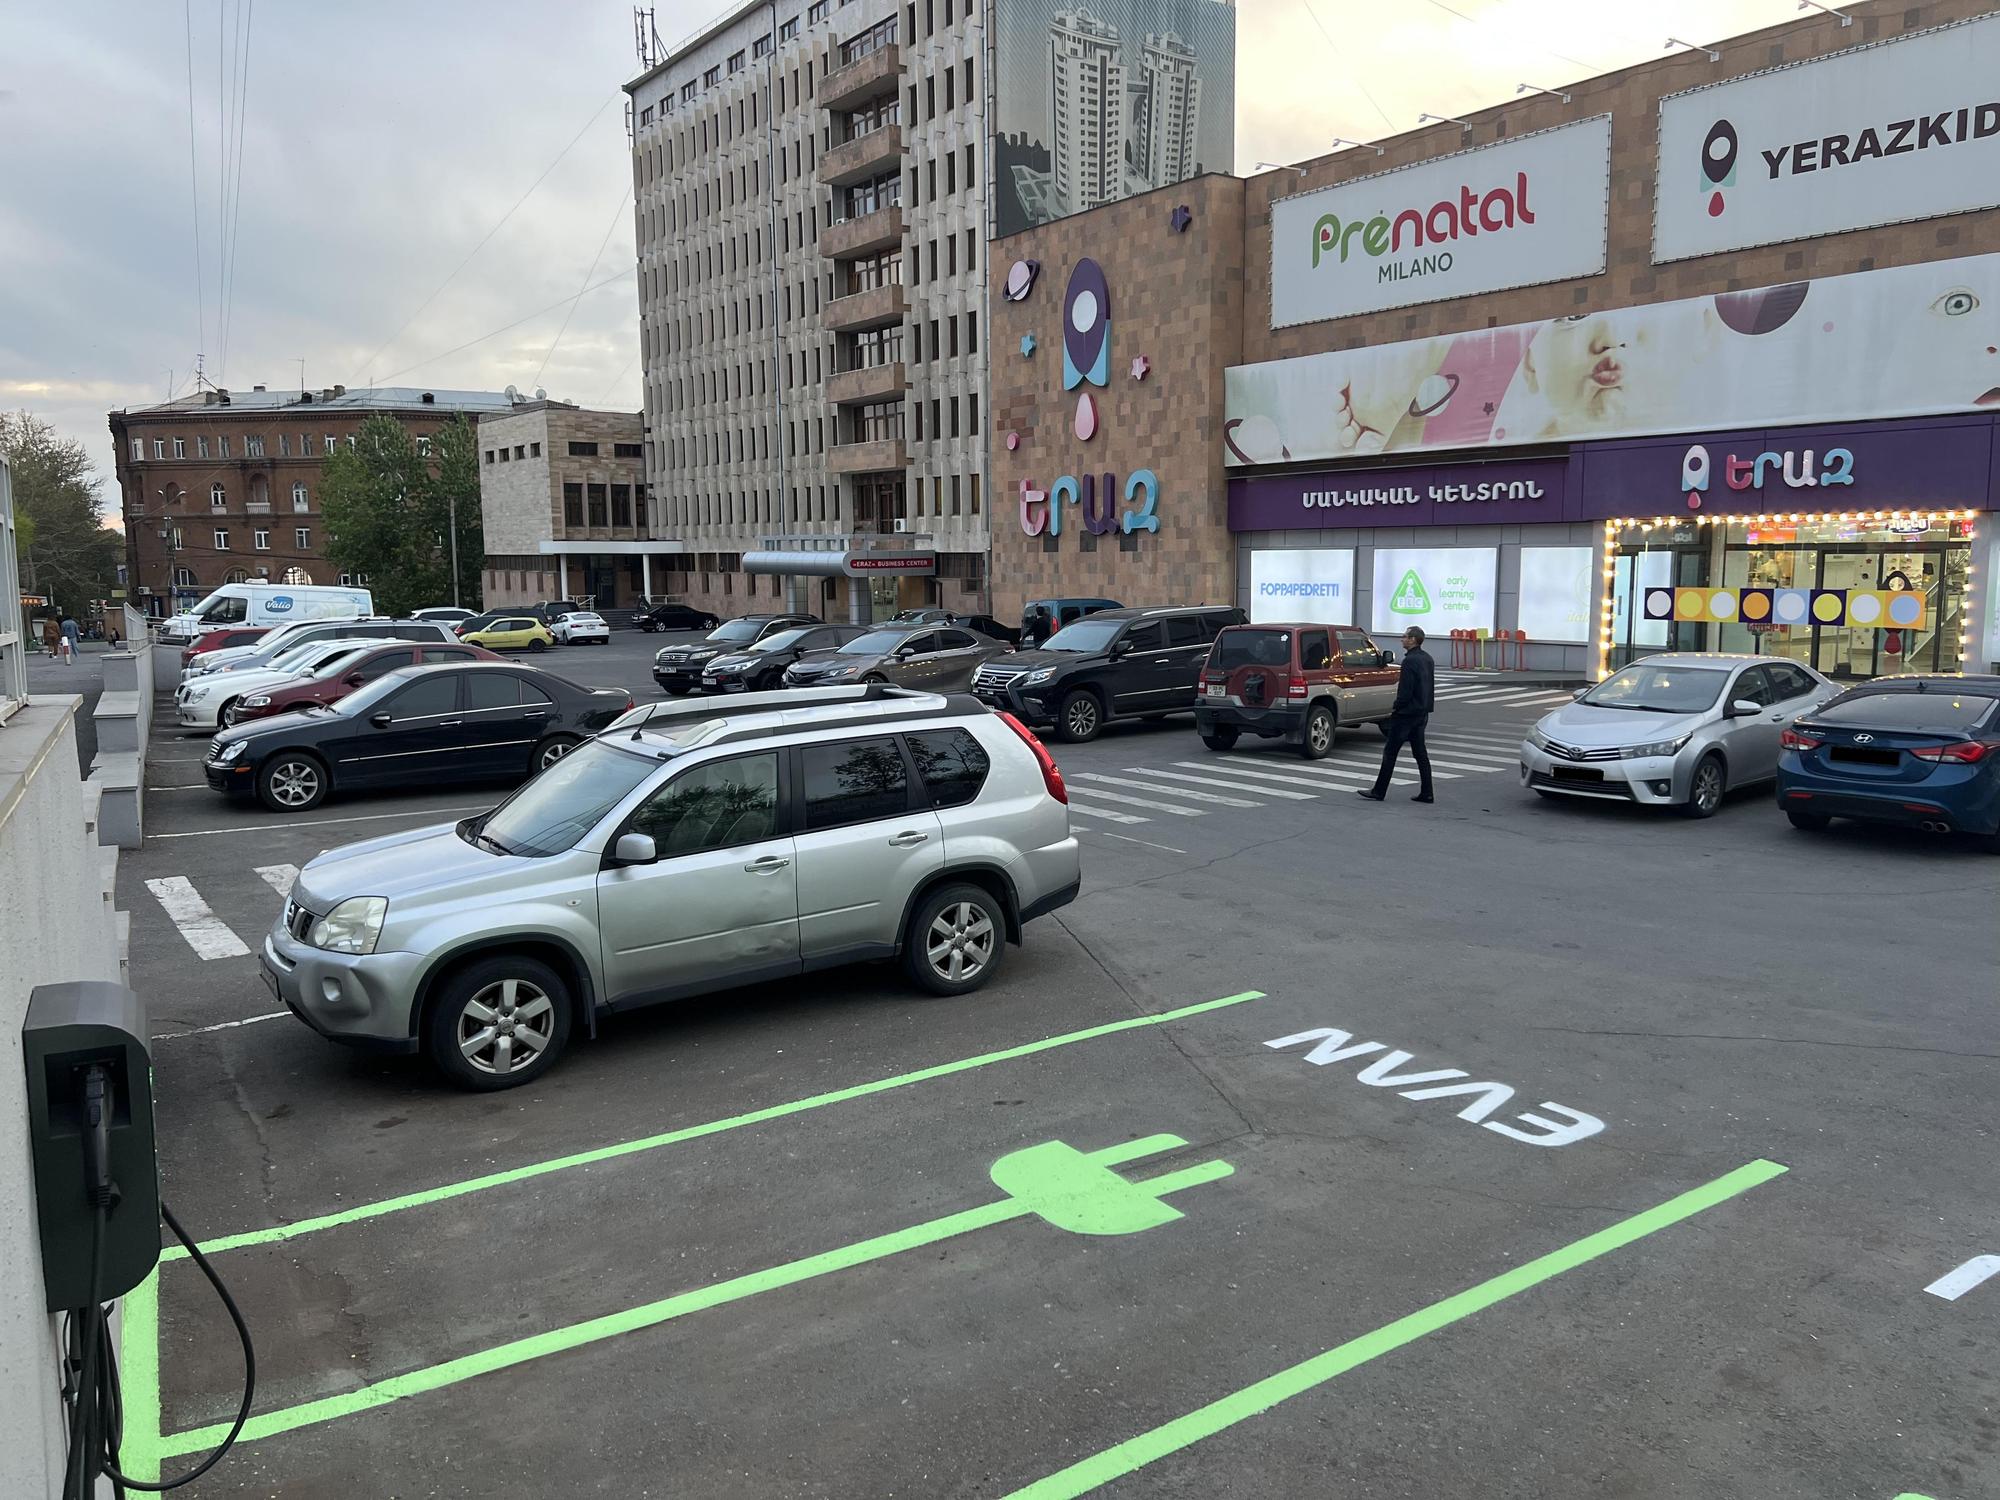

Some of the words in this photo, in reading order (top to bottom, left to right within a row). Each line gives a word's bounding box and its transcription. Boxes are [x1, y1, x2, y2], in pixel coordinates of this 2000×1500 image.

[1378, 252, 1453, 283] MILANO
[1726, 448, 1854, 490] ԵՐԱԶ
[1302, 486, 1420, 508] ՄԱՆԿԱԿԱՆ
[1428, 480, 1545, 502] ԿԵՆՏՐՈՆ
[1019, 469, 1160, 537] ԵՐԱԶ
[1446, 576, 1469, 588] early
[1260, 583, 1340, 597] FOPPAPEDRETTI
[1439, 588, 1475, 601] learning
[266, 600, 291, 609] Valio
[1442, 602, 1471, 611] centre
